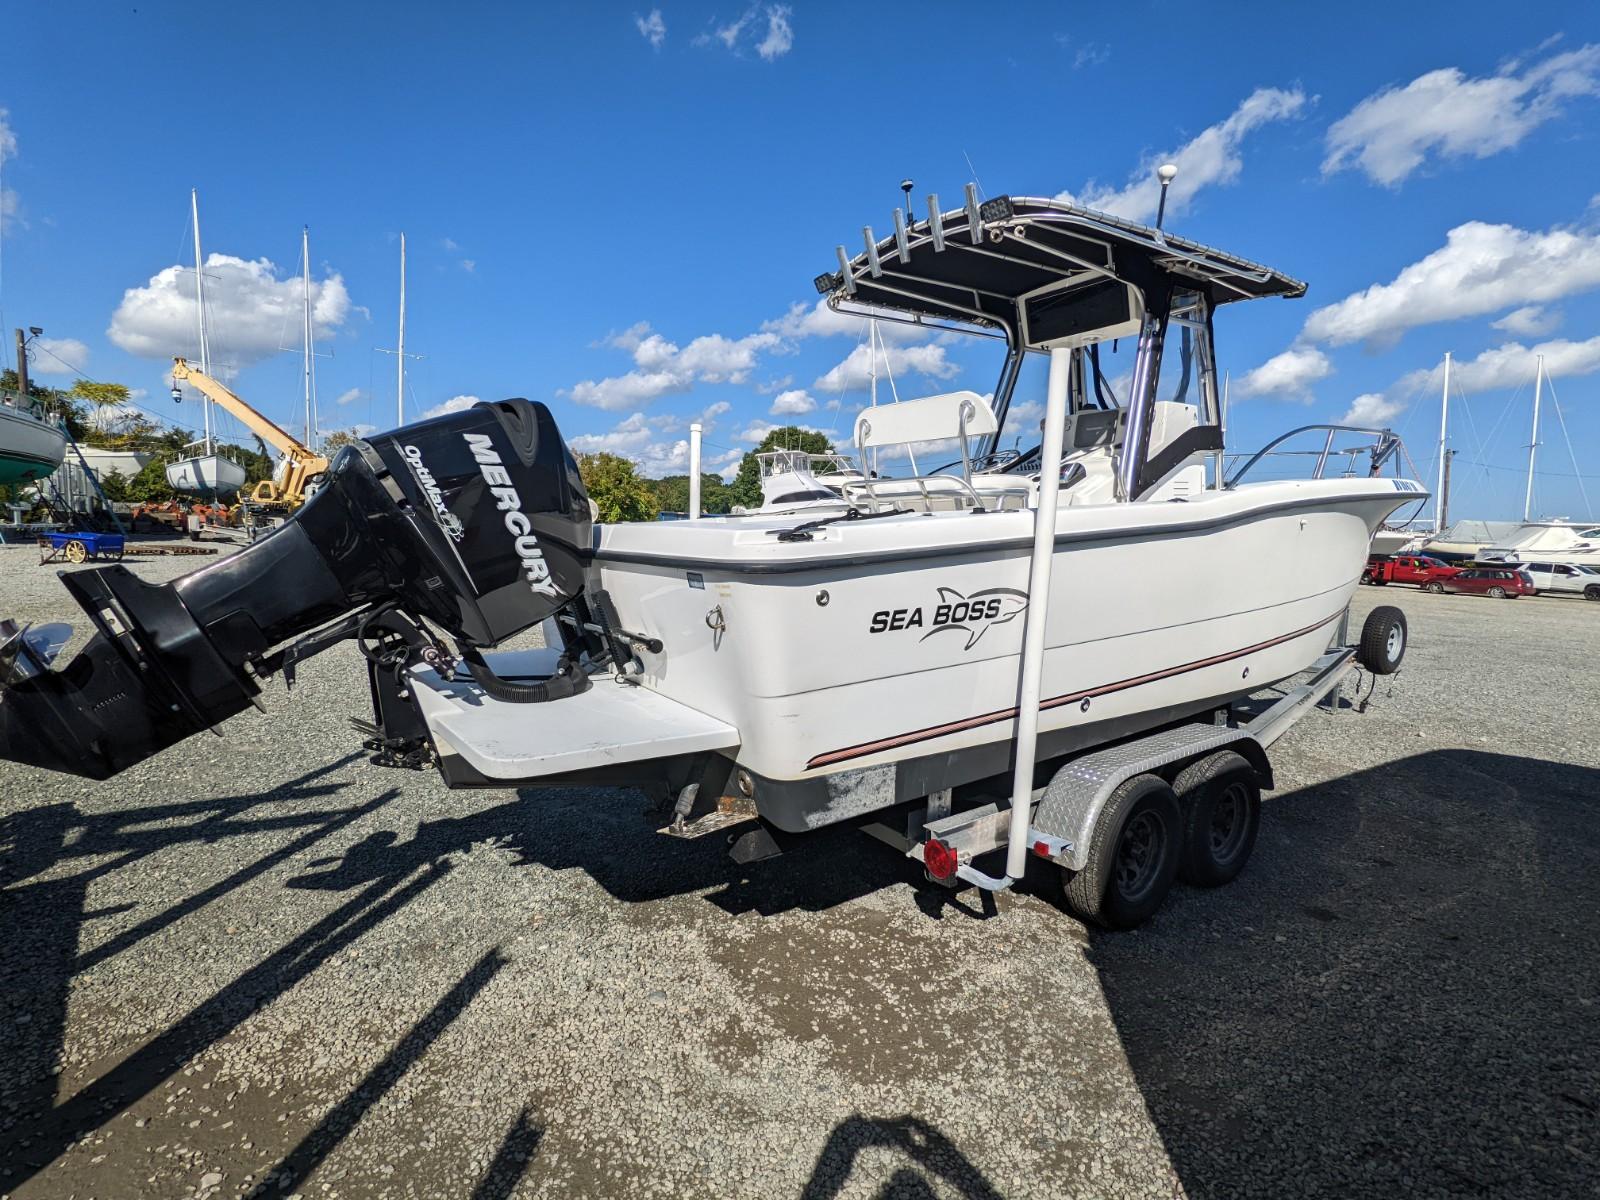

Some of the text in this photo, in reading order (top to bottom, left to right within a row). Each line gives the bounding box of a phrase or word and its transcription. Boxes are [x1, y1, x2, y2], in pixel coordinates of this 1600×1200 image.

[404, 445, 448, 515] OptiMax
[463, 433, 565, 597] MERCURY
[869, 598, 1002, 634] SEA BOSS
